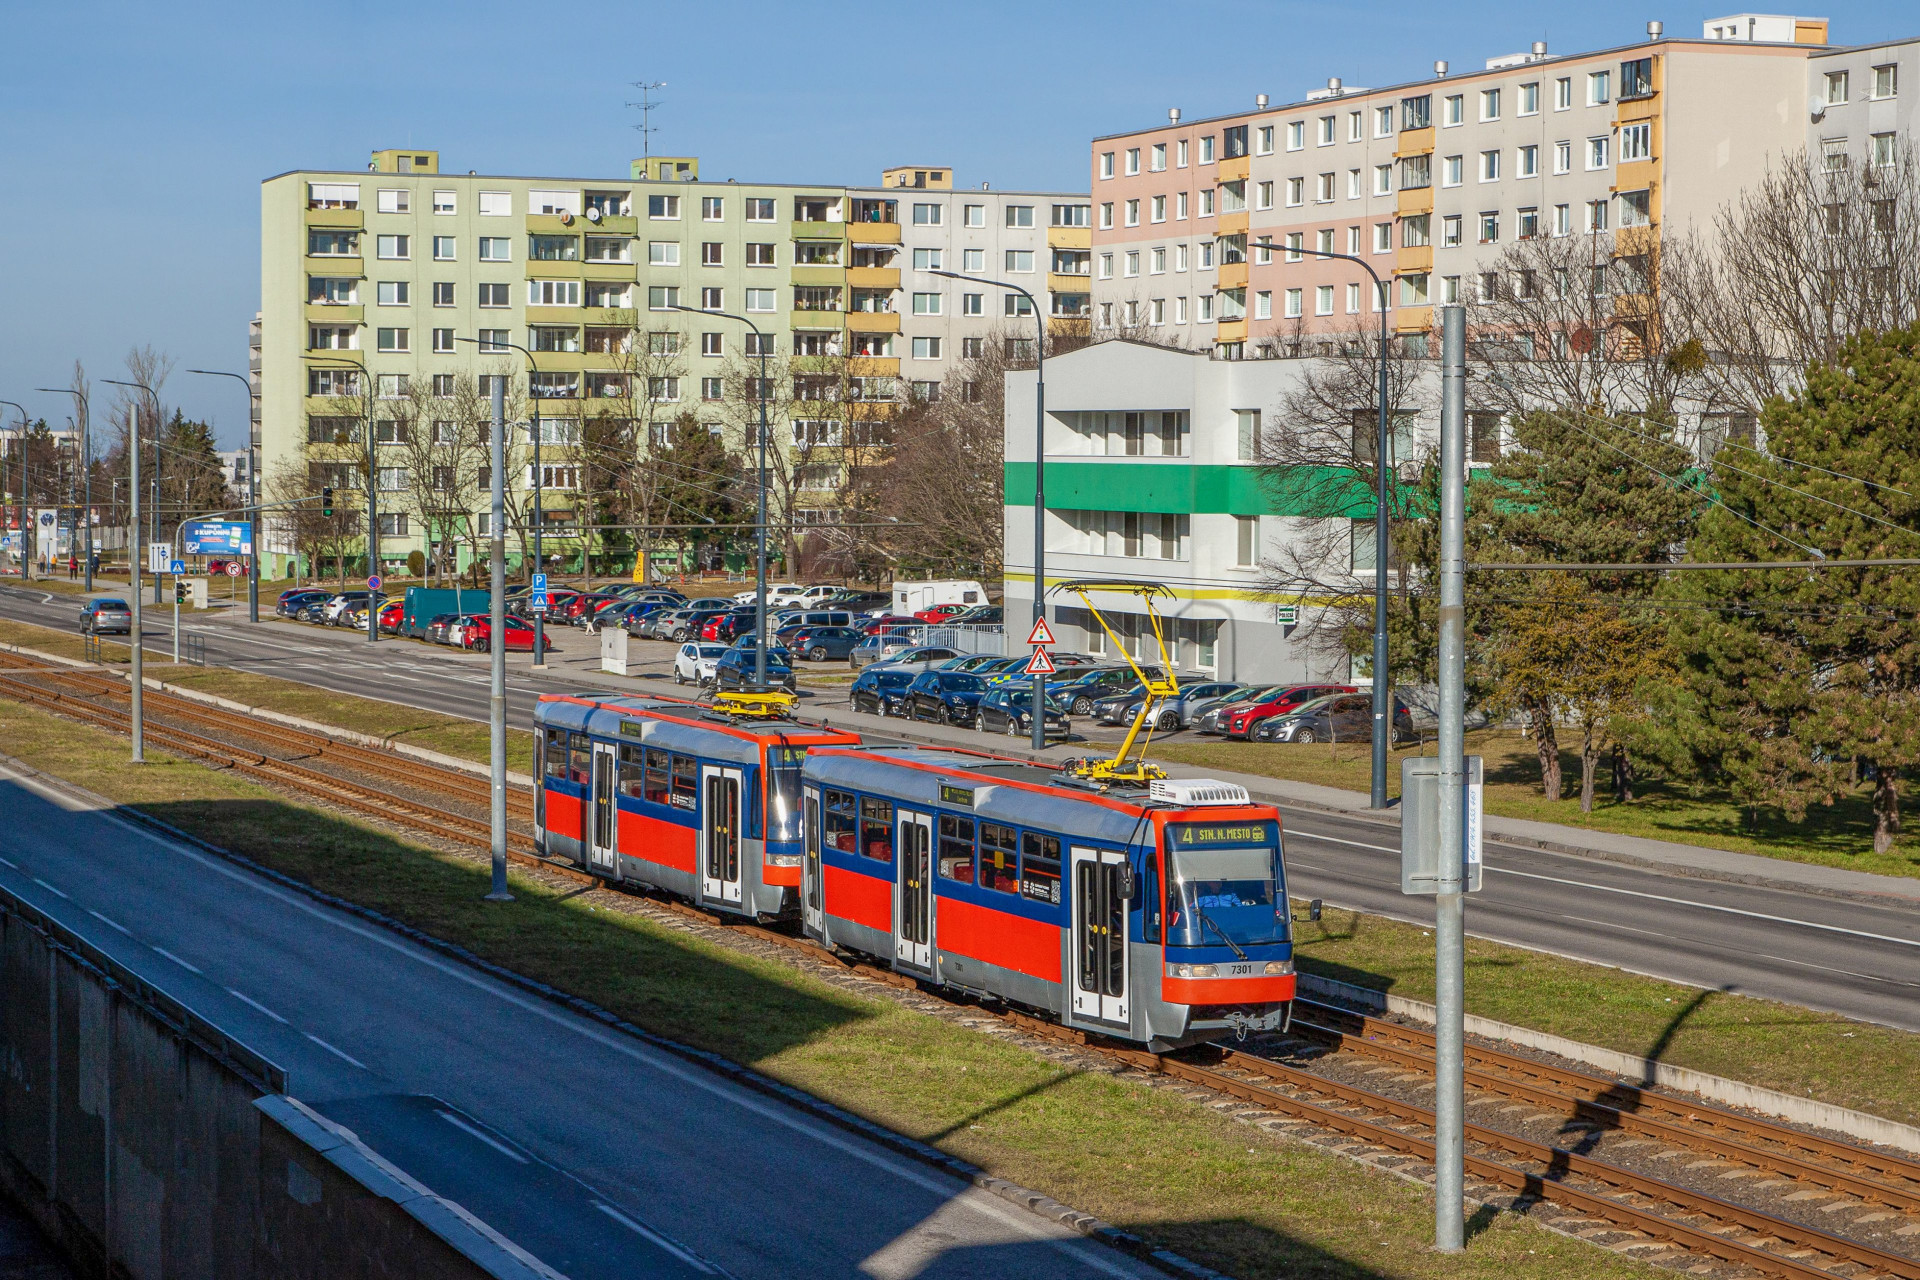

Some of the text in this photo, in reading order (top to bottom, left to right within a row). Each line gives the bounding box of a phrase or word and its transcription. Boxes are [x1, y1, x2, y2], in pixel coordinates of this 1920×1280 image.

[536, 575, 543, 586] P
[784, 748, 791, 762] 4
[944, 787, 949, 800] 4
[1182, 827, 1193, 844] 4
[1226, 828, 1250, 840] MESTO
[1231, 964, 1252, 975] 7301
